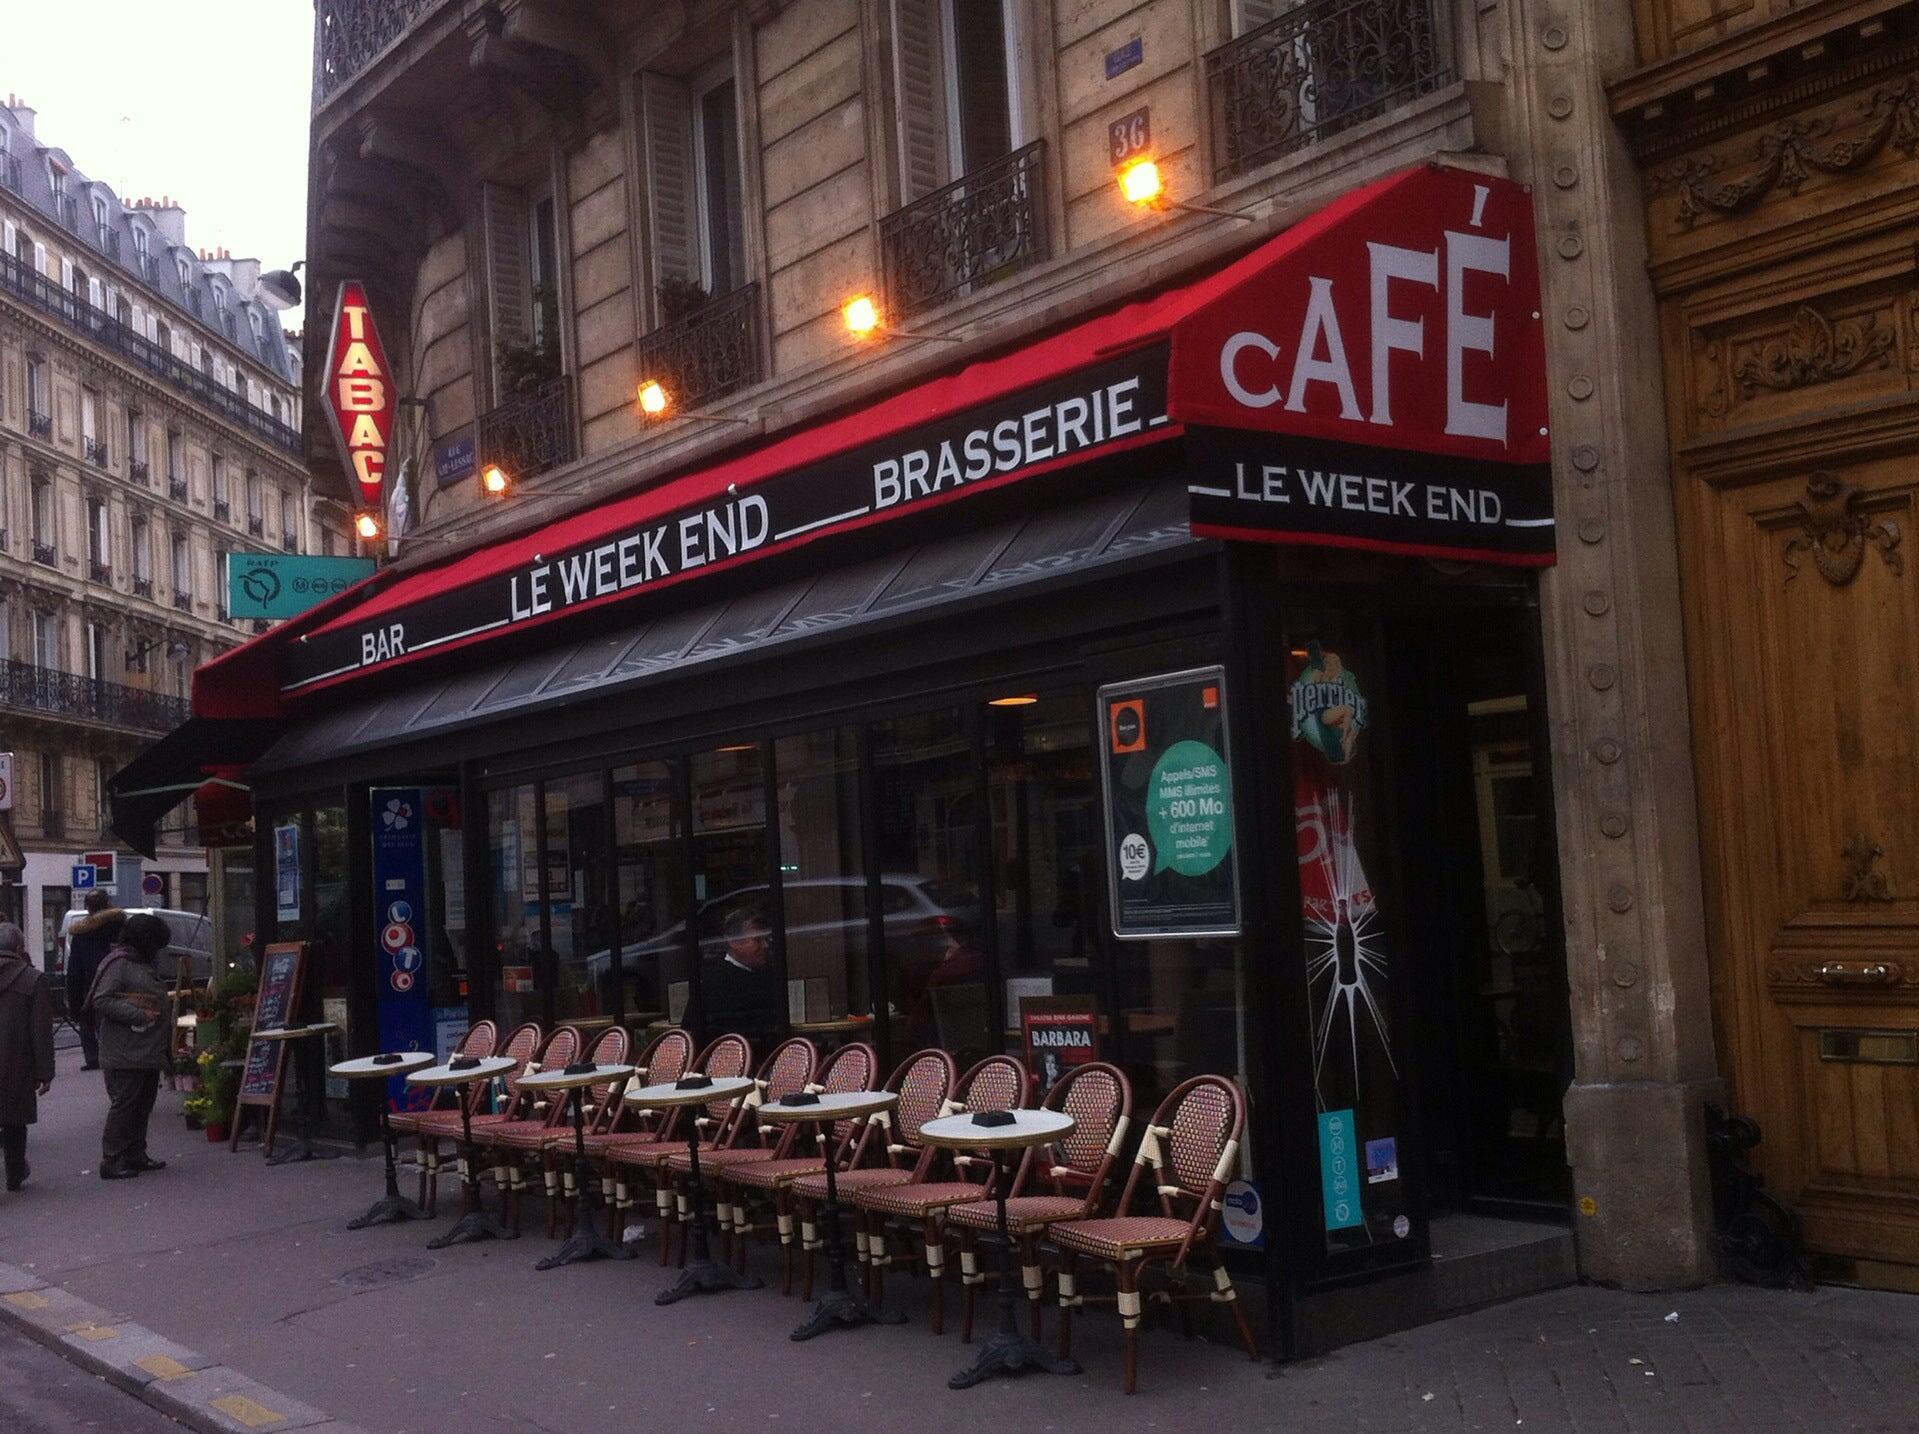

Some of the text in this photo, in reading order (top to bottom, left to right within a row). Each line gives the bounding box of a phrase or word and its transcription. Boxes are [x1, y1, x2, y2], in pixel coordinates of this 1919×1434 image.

[1114, 116, 1145, 157] 36
[1220, 184, 1510, 450] CAFÉ
[338, 306, 386, 484] TABAC
[873, 375, 1141, 510] BRASSERIE
[1236, 462, 1502, 525] LE WEEK END
[246, 559, 279, 568] RATP
[510, 494, 770, 623] LE WEEK END
[361, 623, 407, 666] BAR
[1159, 786, 1183, 799] MMS
[1160, 765, 1217, 783] Appels/SMS
[1159, 797, 1224, 819] + 600 Mo
[1123, 843, 1146, 860] 10€
[78, 869, 90, 885] P
[382, 902, 421, 991] LOTO
[1031, 1030, 1091, 1047] BARBARA
